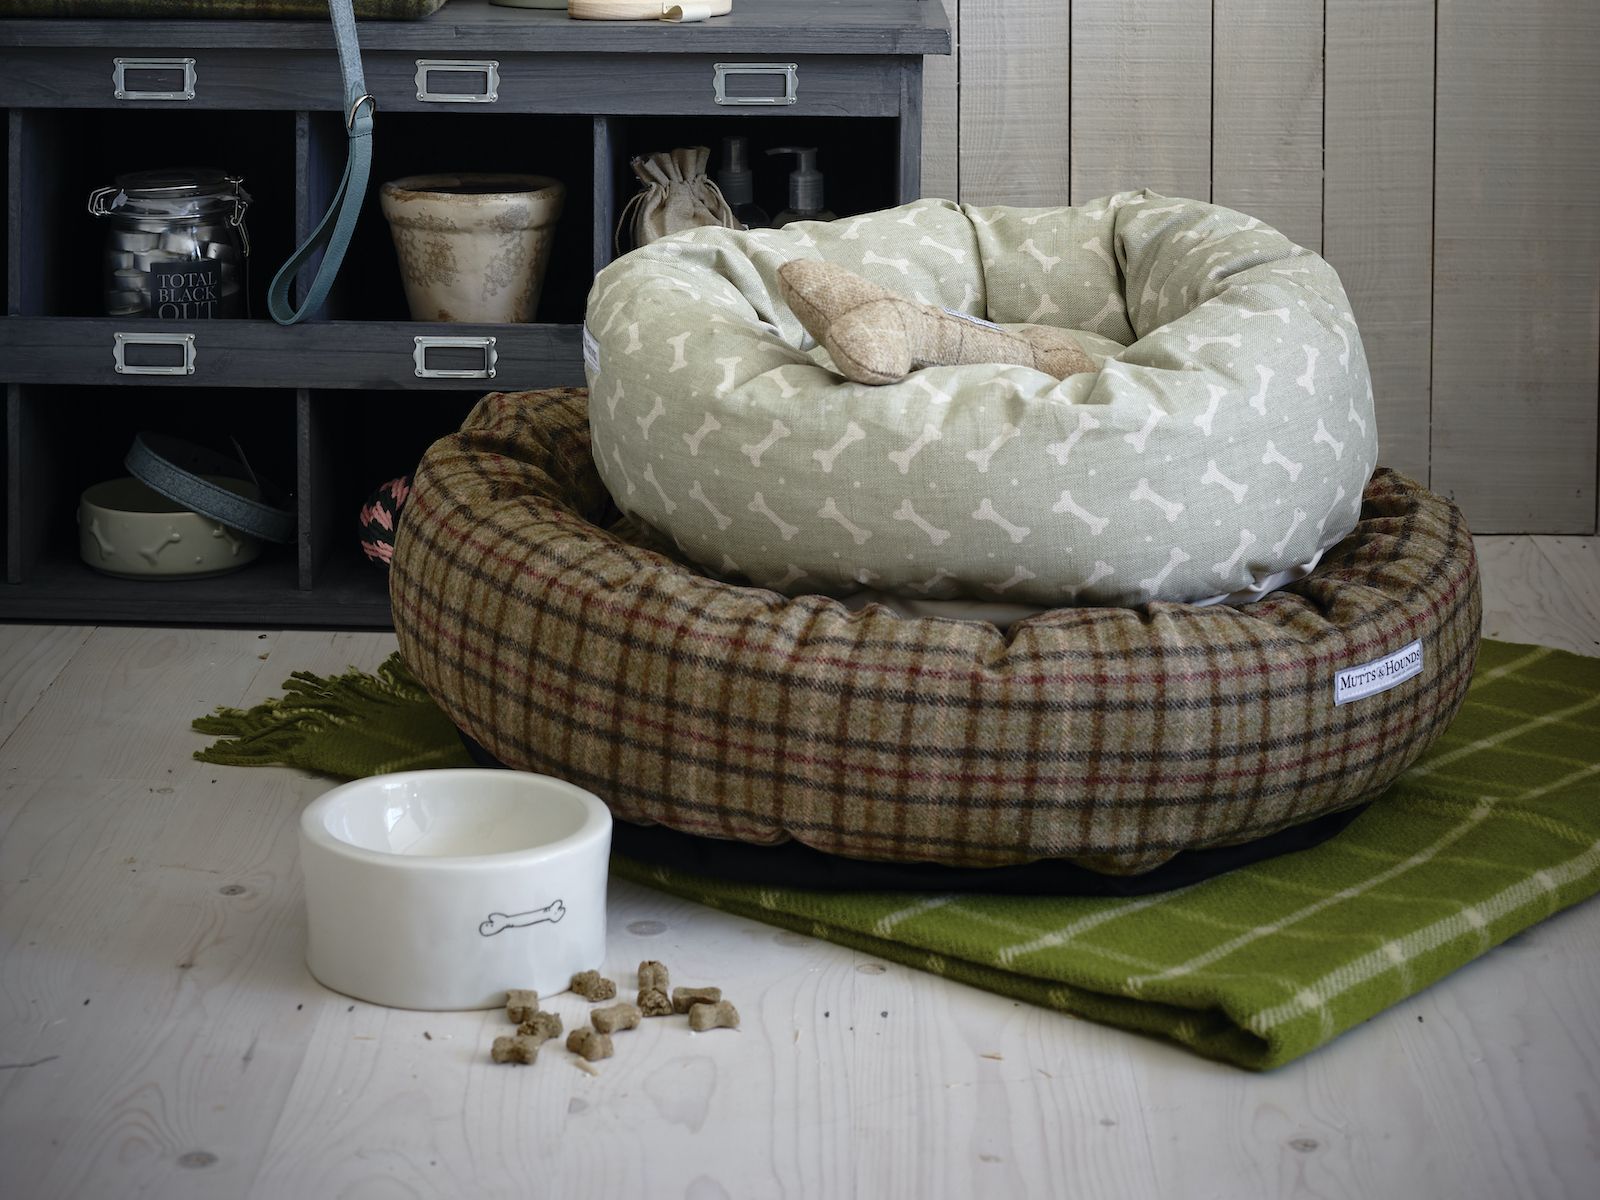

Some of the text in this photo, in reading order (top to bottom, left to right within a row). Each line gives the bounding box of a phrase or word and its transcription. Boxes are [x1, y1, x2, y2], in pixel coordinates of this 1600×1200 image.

[157, 272, 217, 288] TOTAL
[159, 286, 217, 303] BLACK
[158, 301, 217, 320] OUT
[1340, 670, 1377, 690] MUTTS
